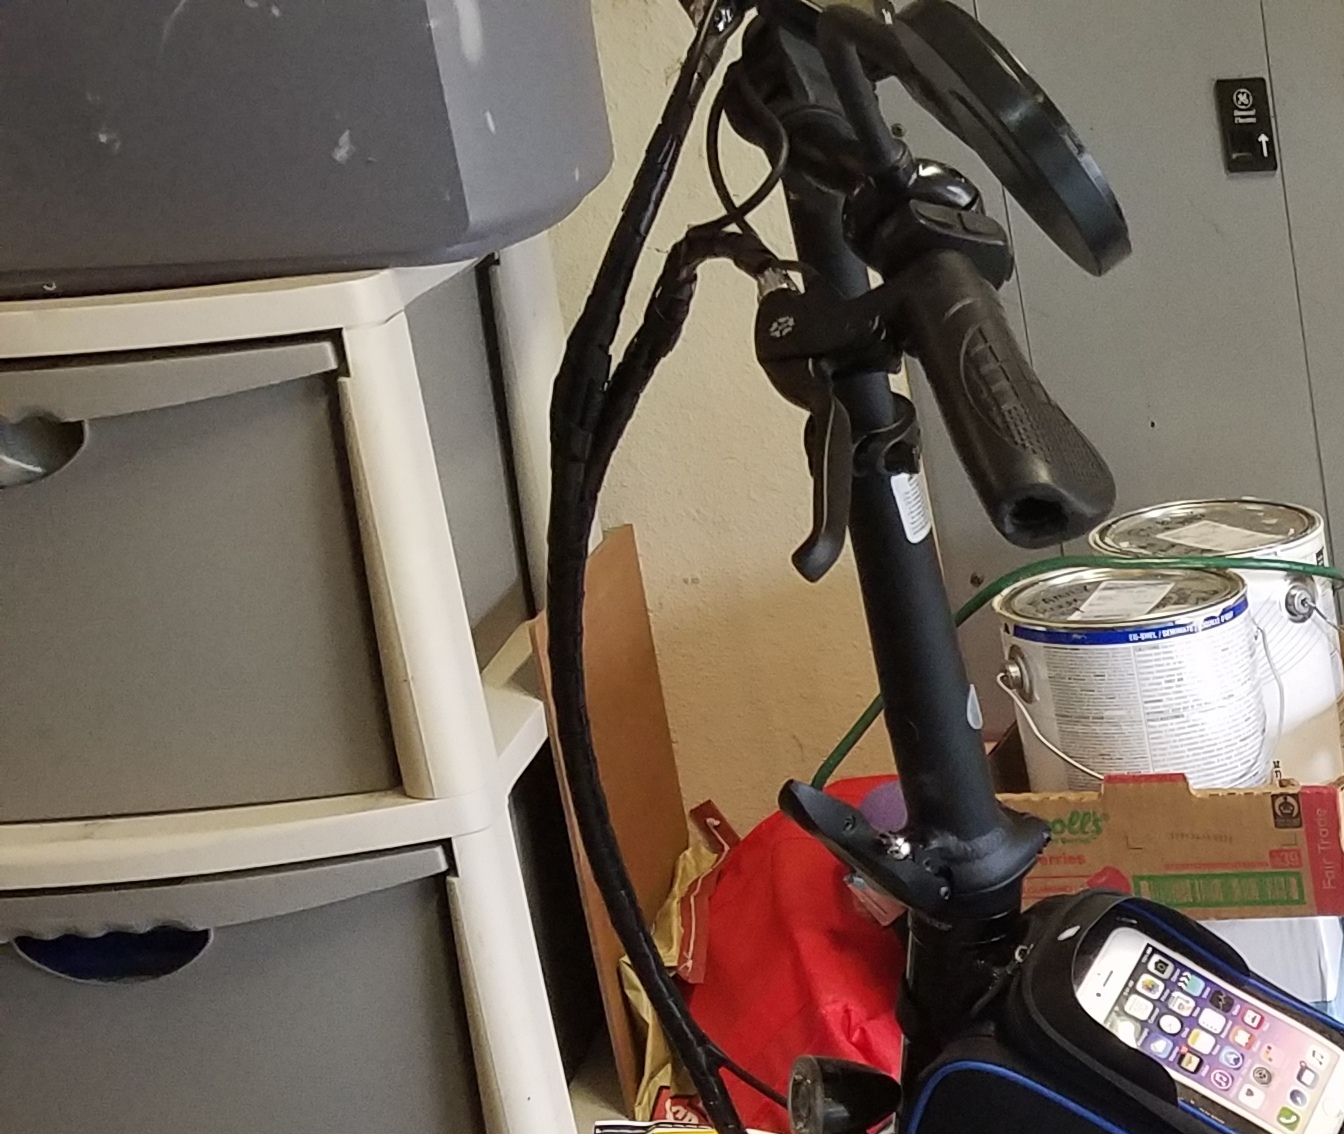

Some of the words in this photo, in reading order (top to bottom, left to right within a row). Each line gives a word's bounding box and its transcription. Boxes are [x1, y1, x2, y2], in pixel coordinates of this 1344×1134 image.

[1316, 807, 1332, 854] Trade
[1037, 853, 1087, 866] erries
[1322, 859, 1337, 890] Fair
